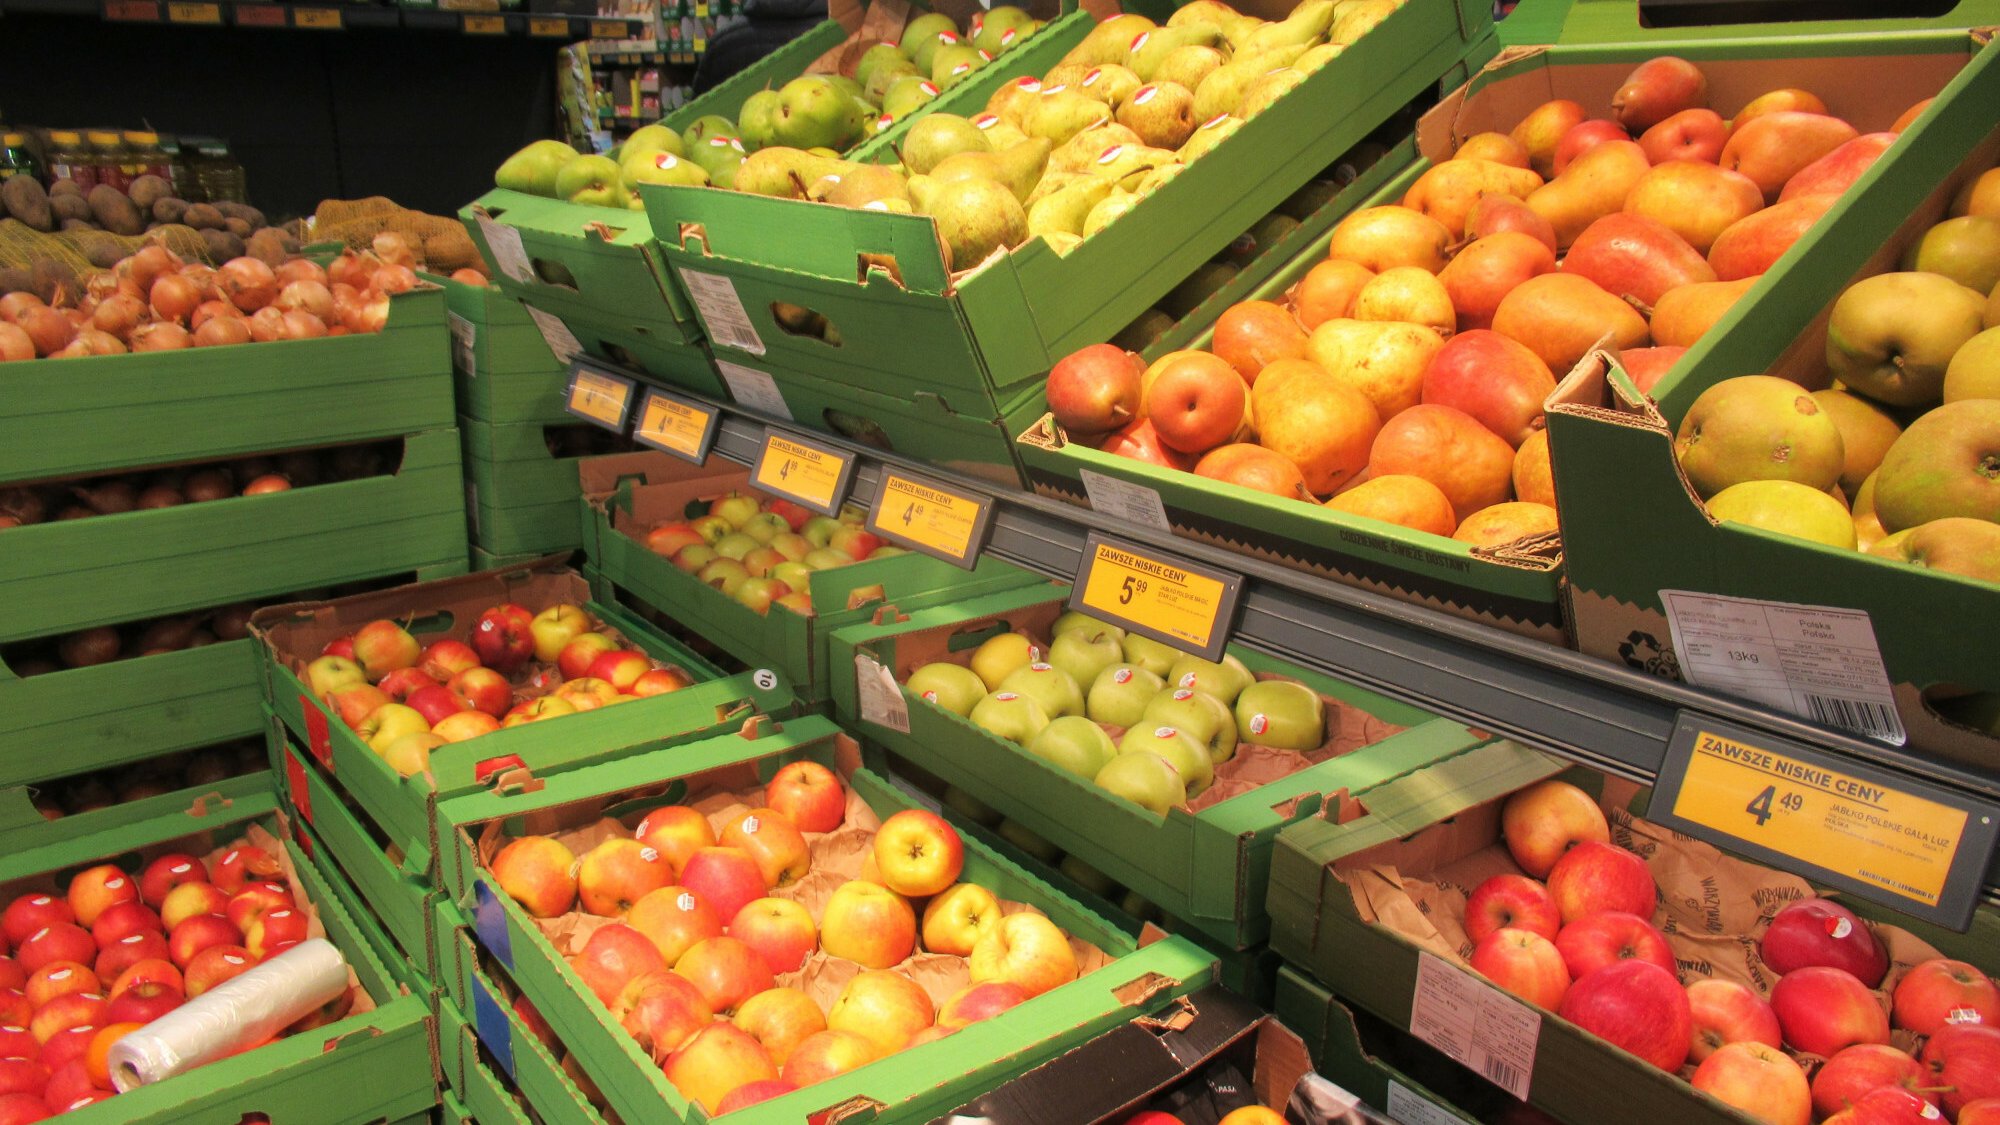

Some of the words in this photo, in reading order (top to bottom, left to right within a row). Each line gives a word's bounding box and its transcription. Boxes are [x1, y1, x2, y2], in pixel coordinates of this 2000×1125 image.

[770, 438, 791, 451] ZAWSZE
[791, 445, 807, 456] NISKIE
[808, 451, 822, 461] CENY
[780, 458, 791, 481] 4
[889, 478, 915, 494] ZAWSZE
[915, 486, 935, 500] NISKIE
[935, 493, 953, 506] CENY
[902, 502, 915, 527] 4
[915, 505, 924, 516] 49
[1339, 531, 1389, 551] CODZIENNIE
[1391, 541, 1423, 561] ŚWIEŻE
[1426, 554, 1470, 572] DOSTAWY
[1100, 548, 1133, 565] ZAWSZE
[1134, 558, 1162, 575] NISKIE
[1163, 567, 1187, 583] CENY
[1119, 575, 1136, 605] 5
[1135, 579, 1148, 593] 99
[1799, 619, 1832, 631] Polska
[1802, 629, 1836, 640] Polsko
[1727, 650, 1759, 664] 13kg
[759, 674, 772, 687] 10
[1702, 736, 1772, 770] ZAWSZE
[1775, 759, 1831, 787] NISKIE
[1834, 778, 1887, 804] CENY
[1746, 785, 1776, 826] 4
[1780, 791, 1804, 812] 49
[1829, 803, 1864, 820] JABŁKO
[1865, 814, 1902, 833] POLSKIE
[1904, 827, 1929, 843] GALA
[1930, 835, 1950, 848] LUZ
